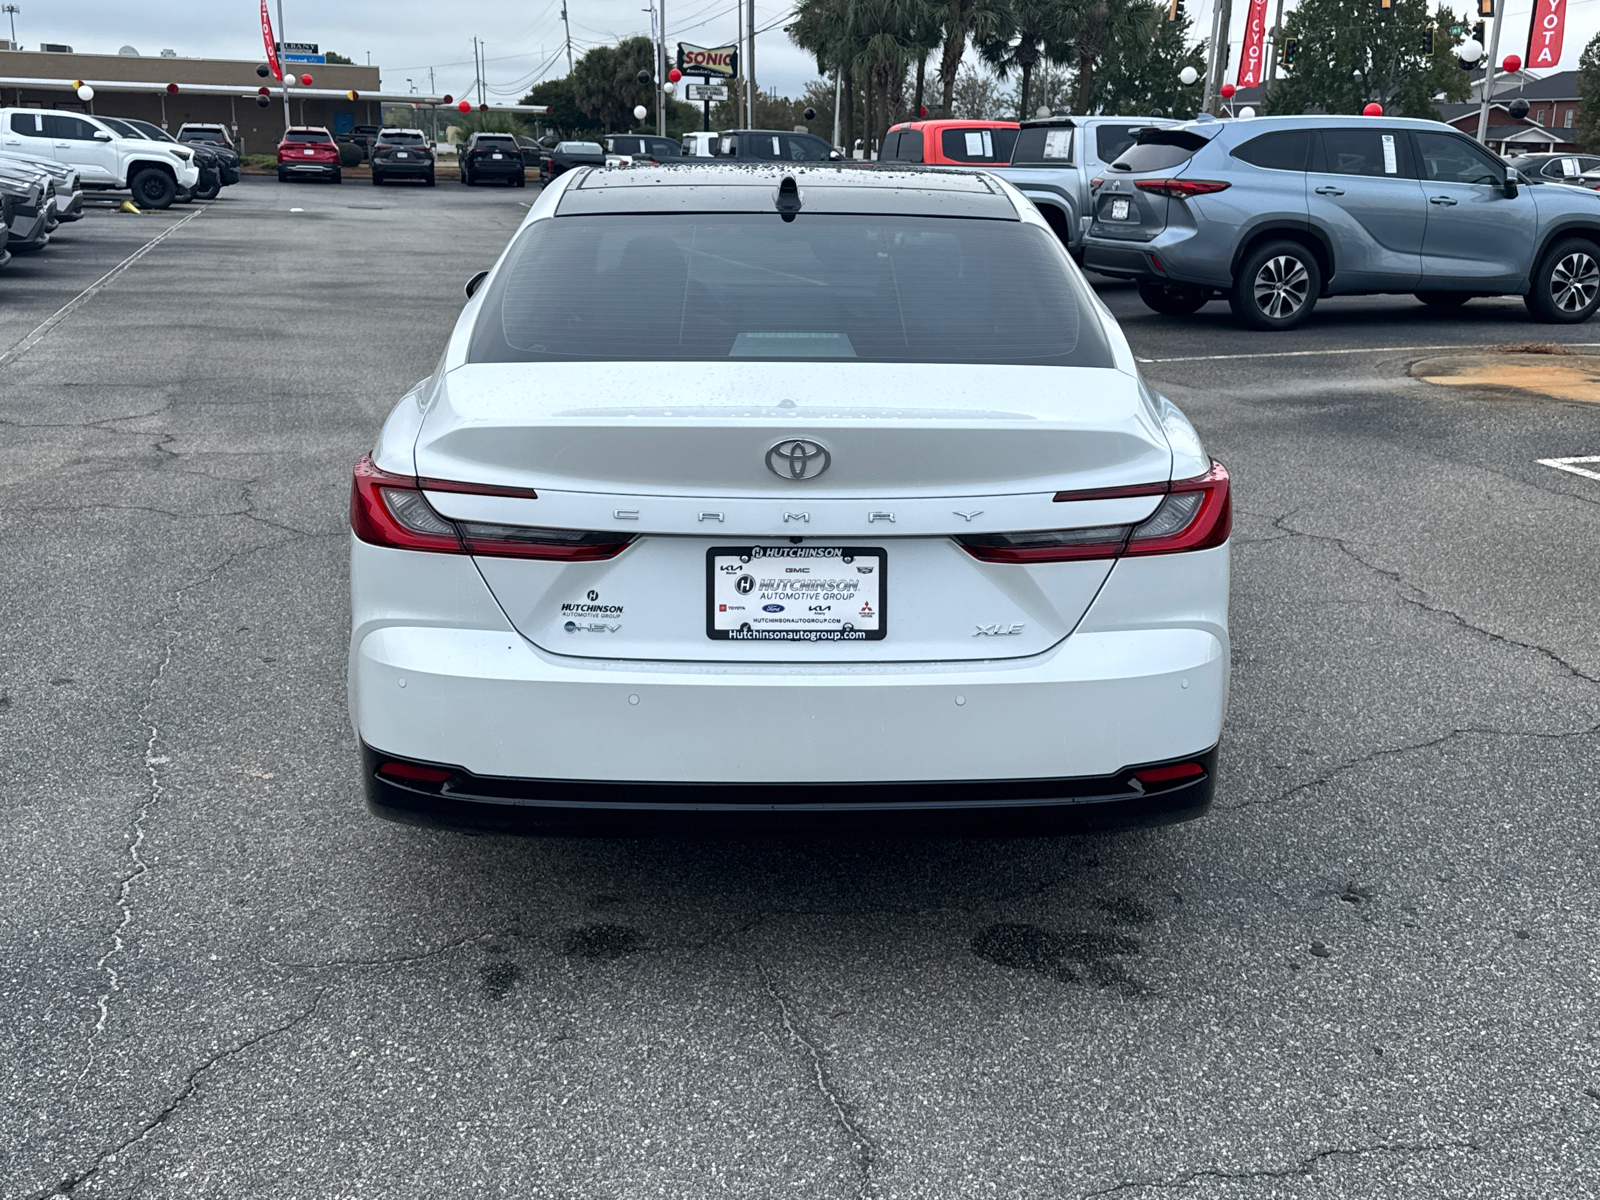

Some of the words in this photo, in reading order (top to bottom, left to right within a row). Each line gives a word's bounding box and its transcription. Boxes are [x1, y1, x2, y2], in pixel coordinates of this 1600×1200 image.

[685, 51, 732, 66] SONIC
[613, 509, 984, 523] CAMRY
[765, 548, 843, 558] HUTCHINSON
[758, 579, 859, 591] HUTCHINSON
[760, 592, 821, 600] AUTOMOTIVE
[823, 592, 855, 600] GROUP
[561, 603, 624, 613] HUTCHINSON
[765, 604, 781, 612] Ford
[729, 629, 866, 641] Hutchinsonautogroup.com
[972, 623, 1025, 637] XLE
